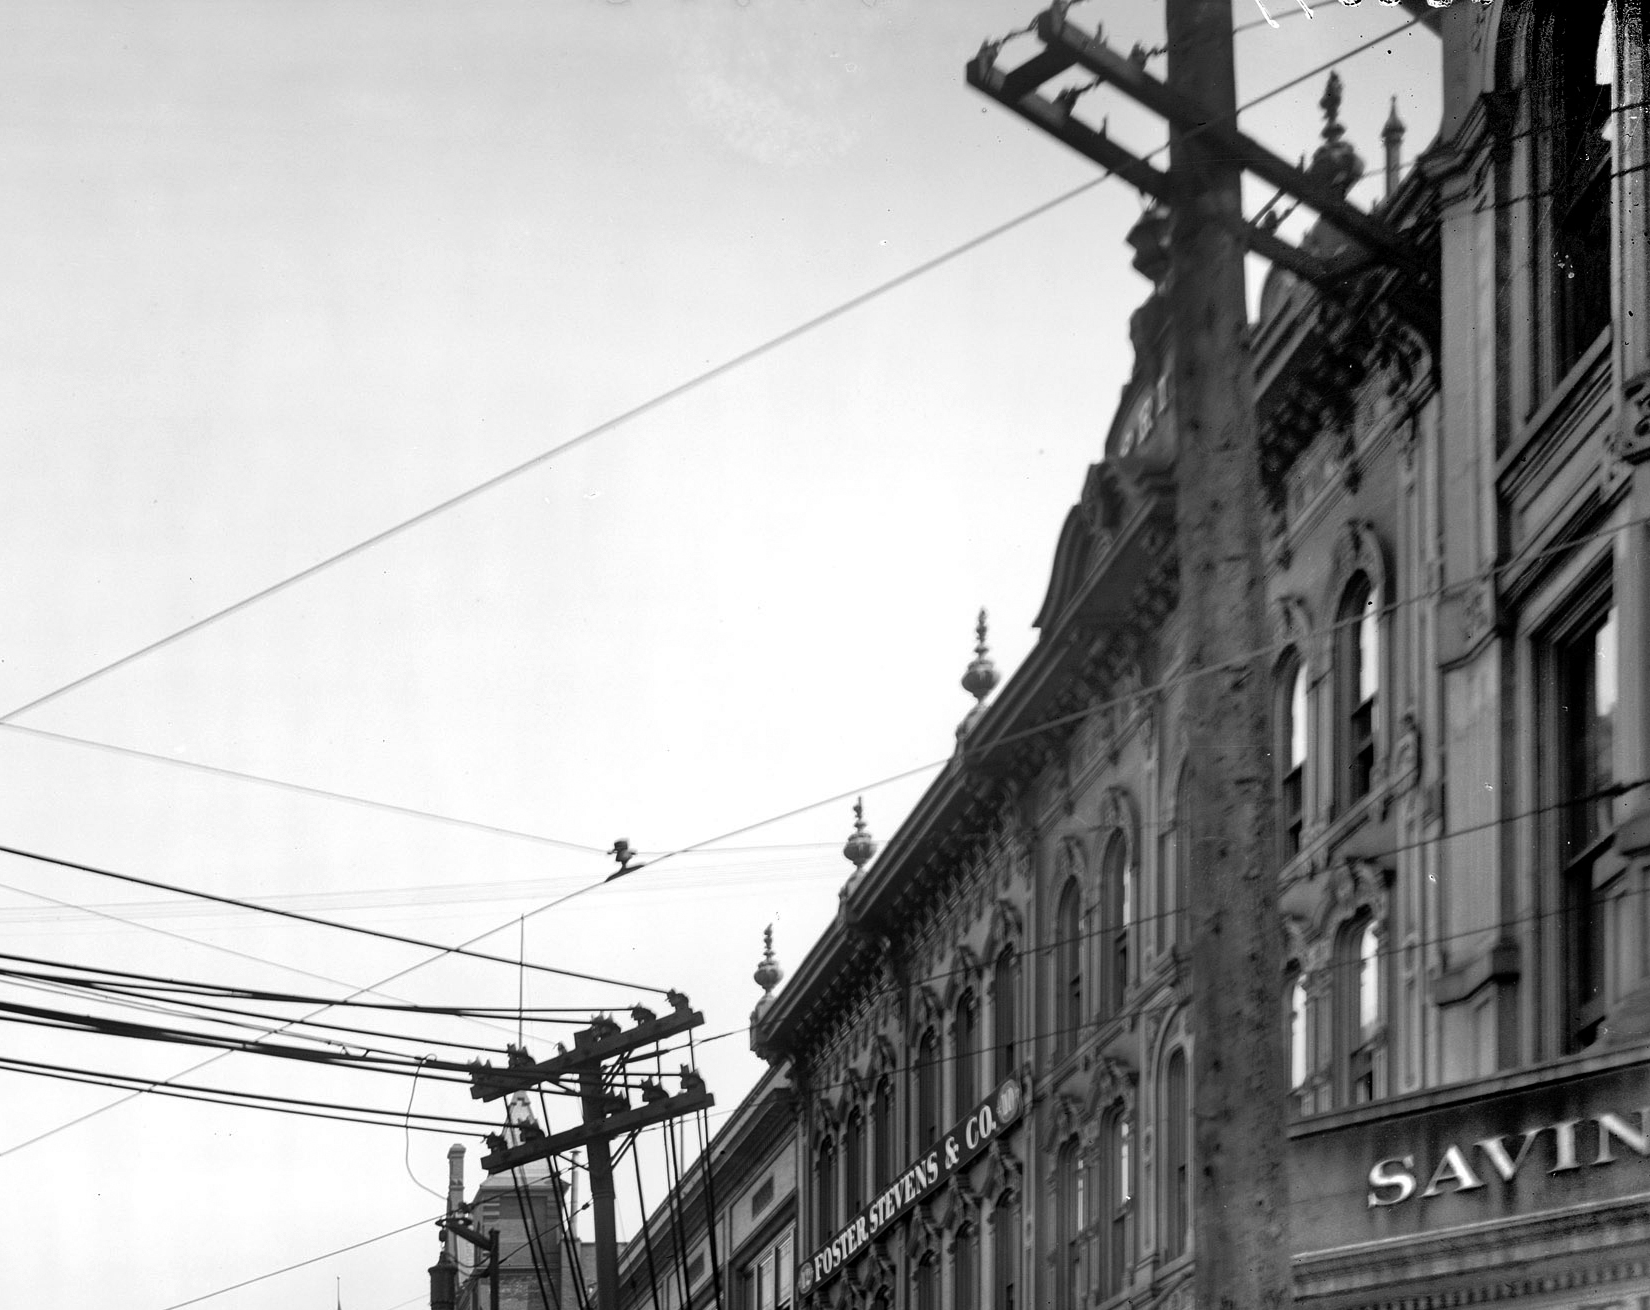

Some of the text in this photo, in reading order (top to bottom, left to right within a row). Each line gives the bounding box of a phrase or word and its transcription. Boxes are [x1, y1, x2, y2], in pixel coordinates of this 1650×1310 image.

[814, 1216, 869, 1282] FOSTER
[869, 1152, 938, 1233] STEVENS
[945, 1136, 960, 1170] &
[966, 1105, 997, 1150] CO.
